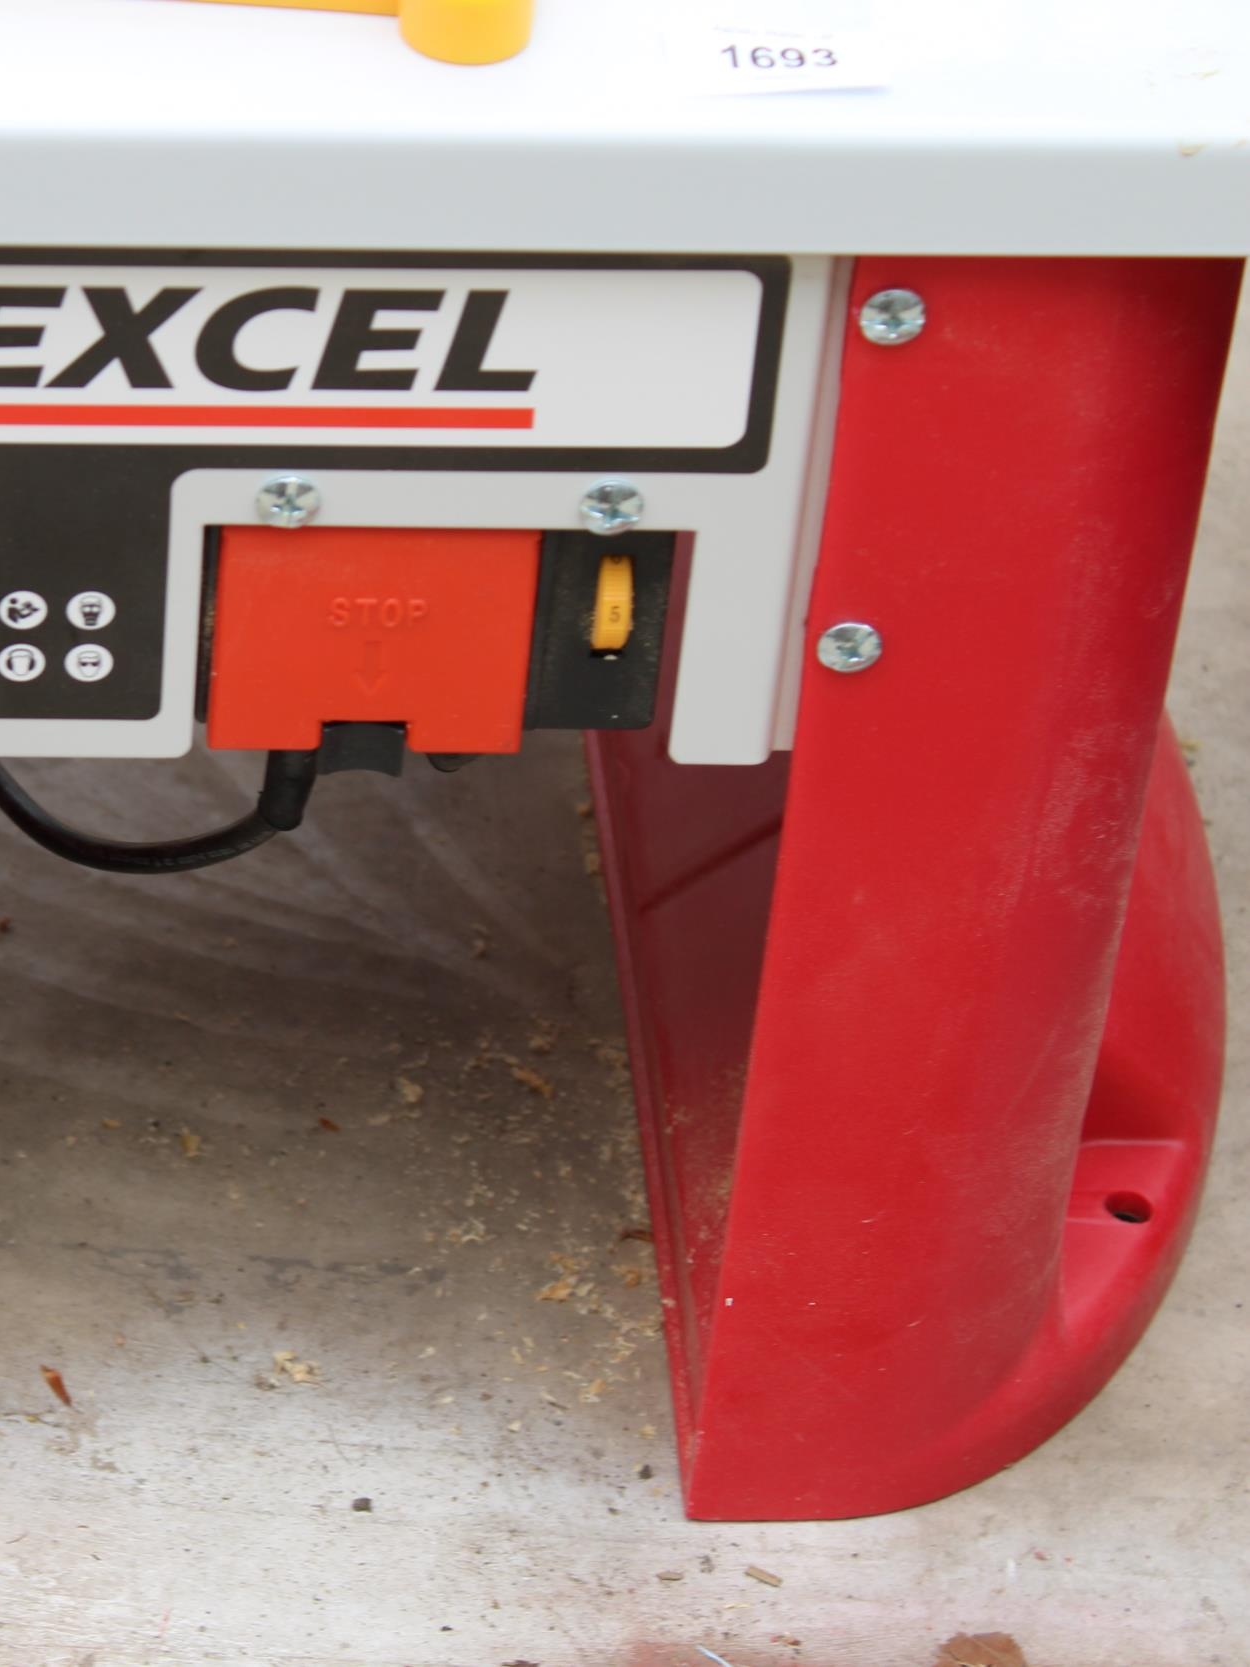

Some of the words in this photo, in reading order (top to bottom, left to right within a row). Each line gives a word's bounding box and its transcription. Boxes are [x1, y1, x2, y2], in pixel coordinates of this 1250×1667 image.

[721, 44, 838, 69] 1693
[328, 597, 428, 628] STOP
[608, 605, 621, 623] 5
